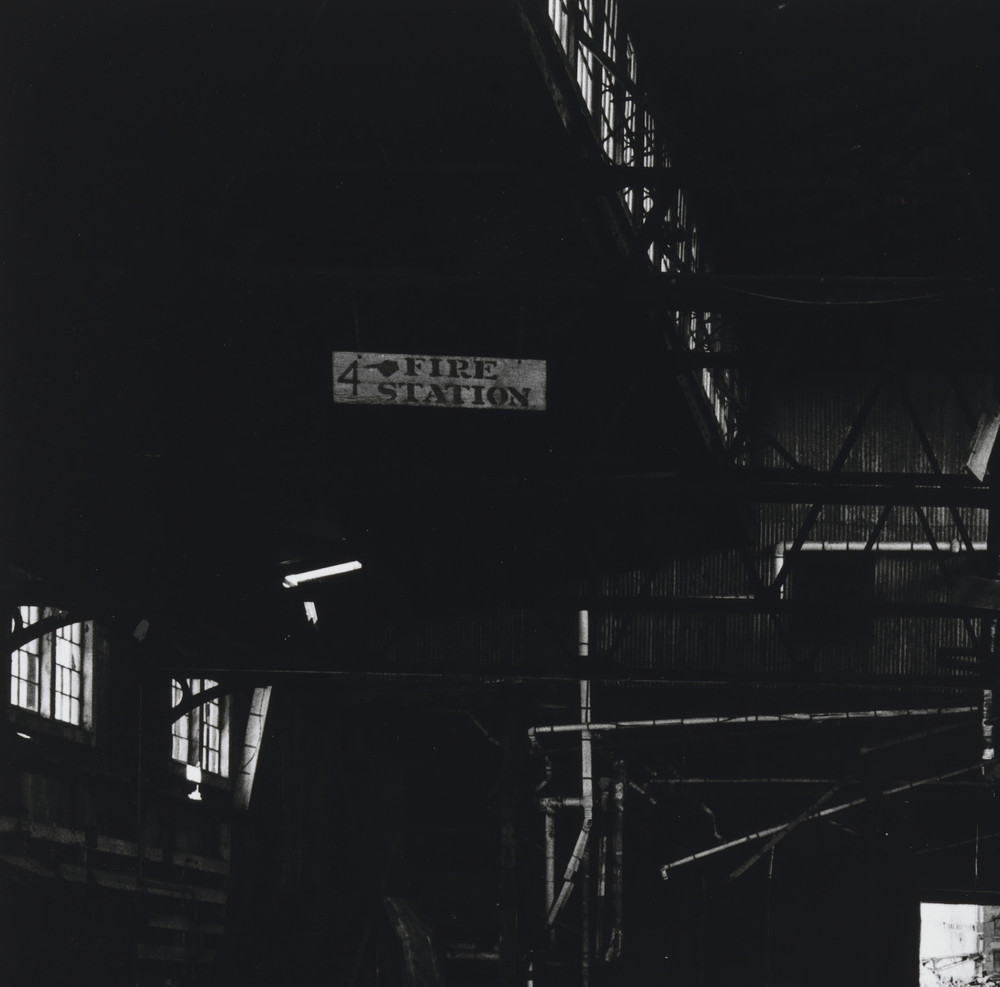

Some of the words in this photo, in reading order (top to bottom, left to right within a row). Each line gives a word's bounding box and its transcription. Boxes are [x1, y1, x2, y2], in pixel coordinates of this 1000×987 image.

[337, 359, 360, 397] 4
[404, 357, 498, 380] FIRE
[378, 381, 532, 408] STATION
